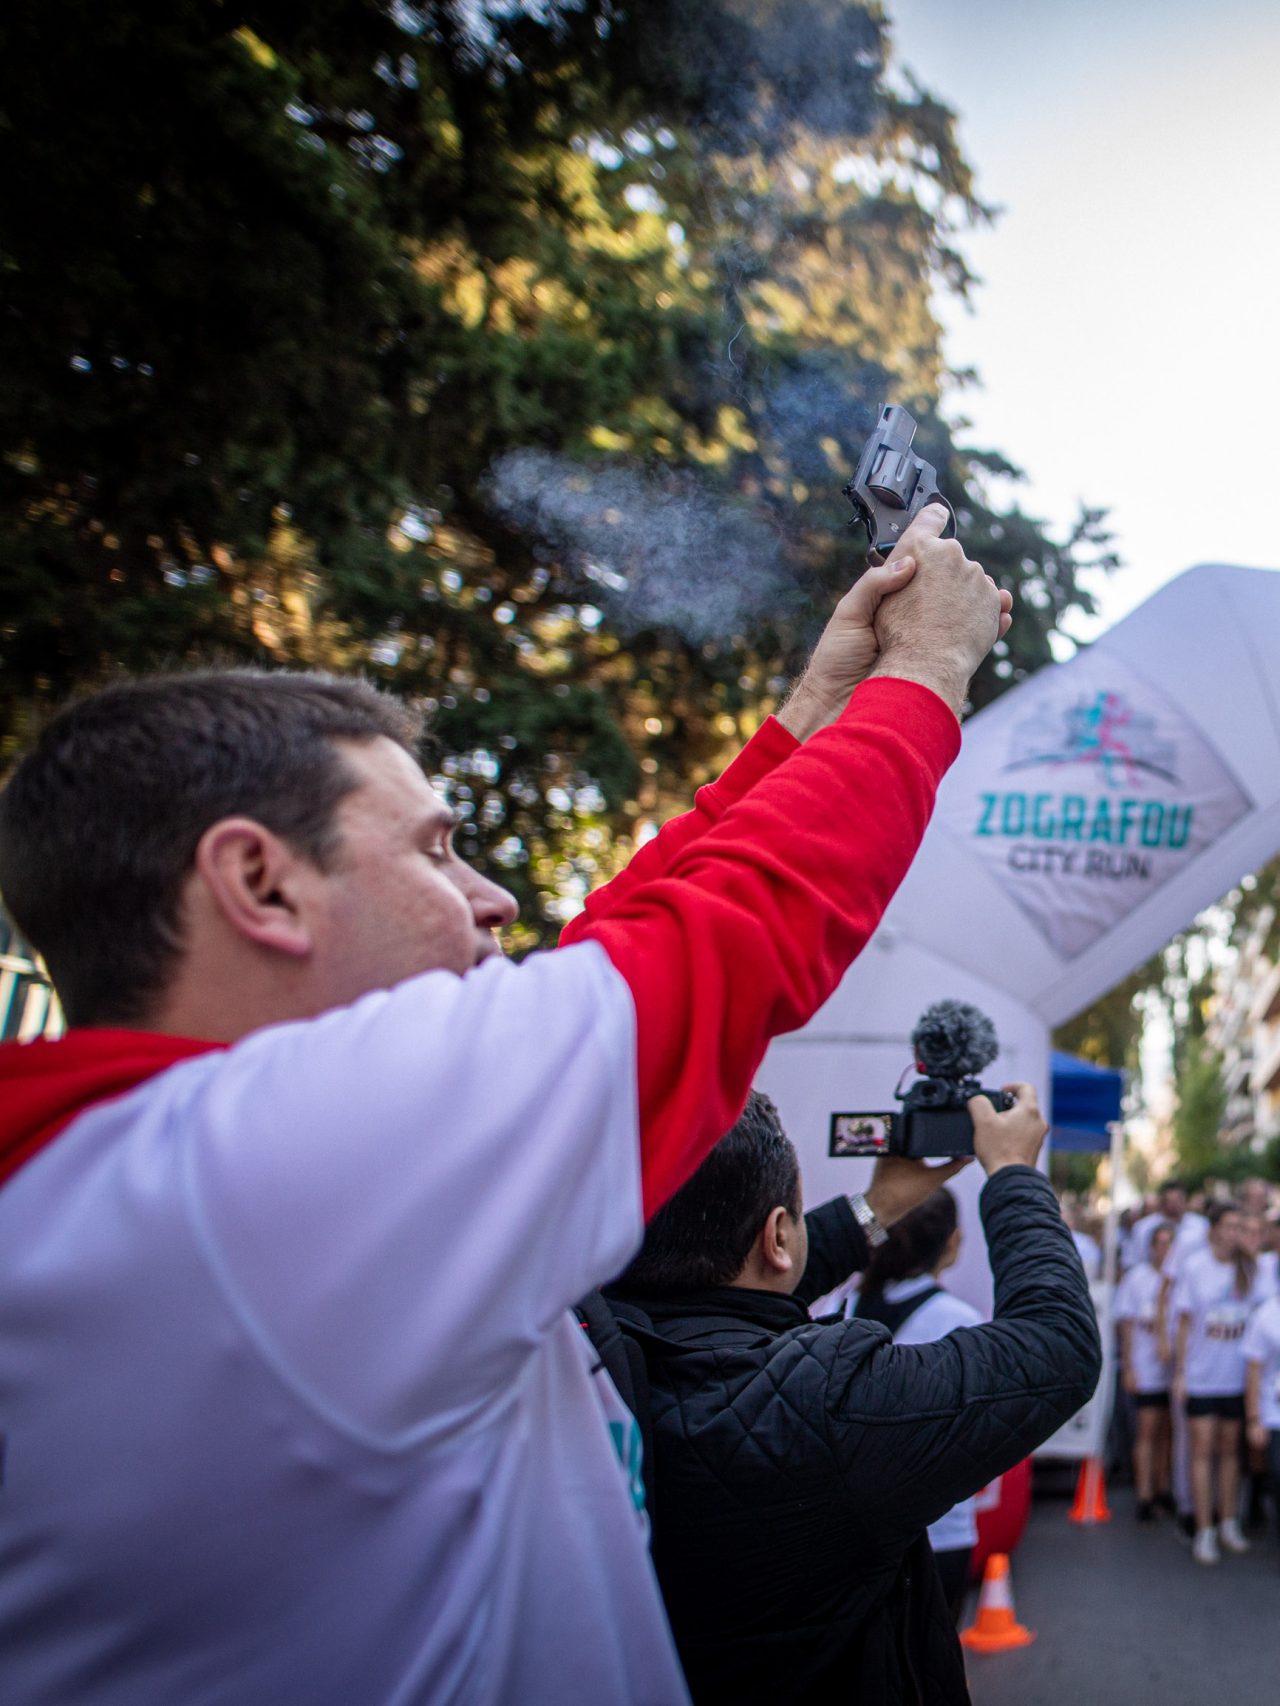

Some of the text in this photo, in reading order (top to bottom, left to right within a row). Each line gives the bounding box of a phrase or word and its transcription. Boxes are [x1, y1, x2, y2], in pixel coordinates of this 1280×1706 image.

[975, 791, 1195, 849] ZOGRAFOU
[1007, 844, 1152, 879] CITY RUN
